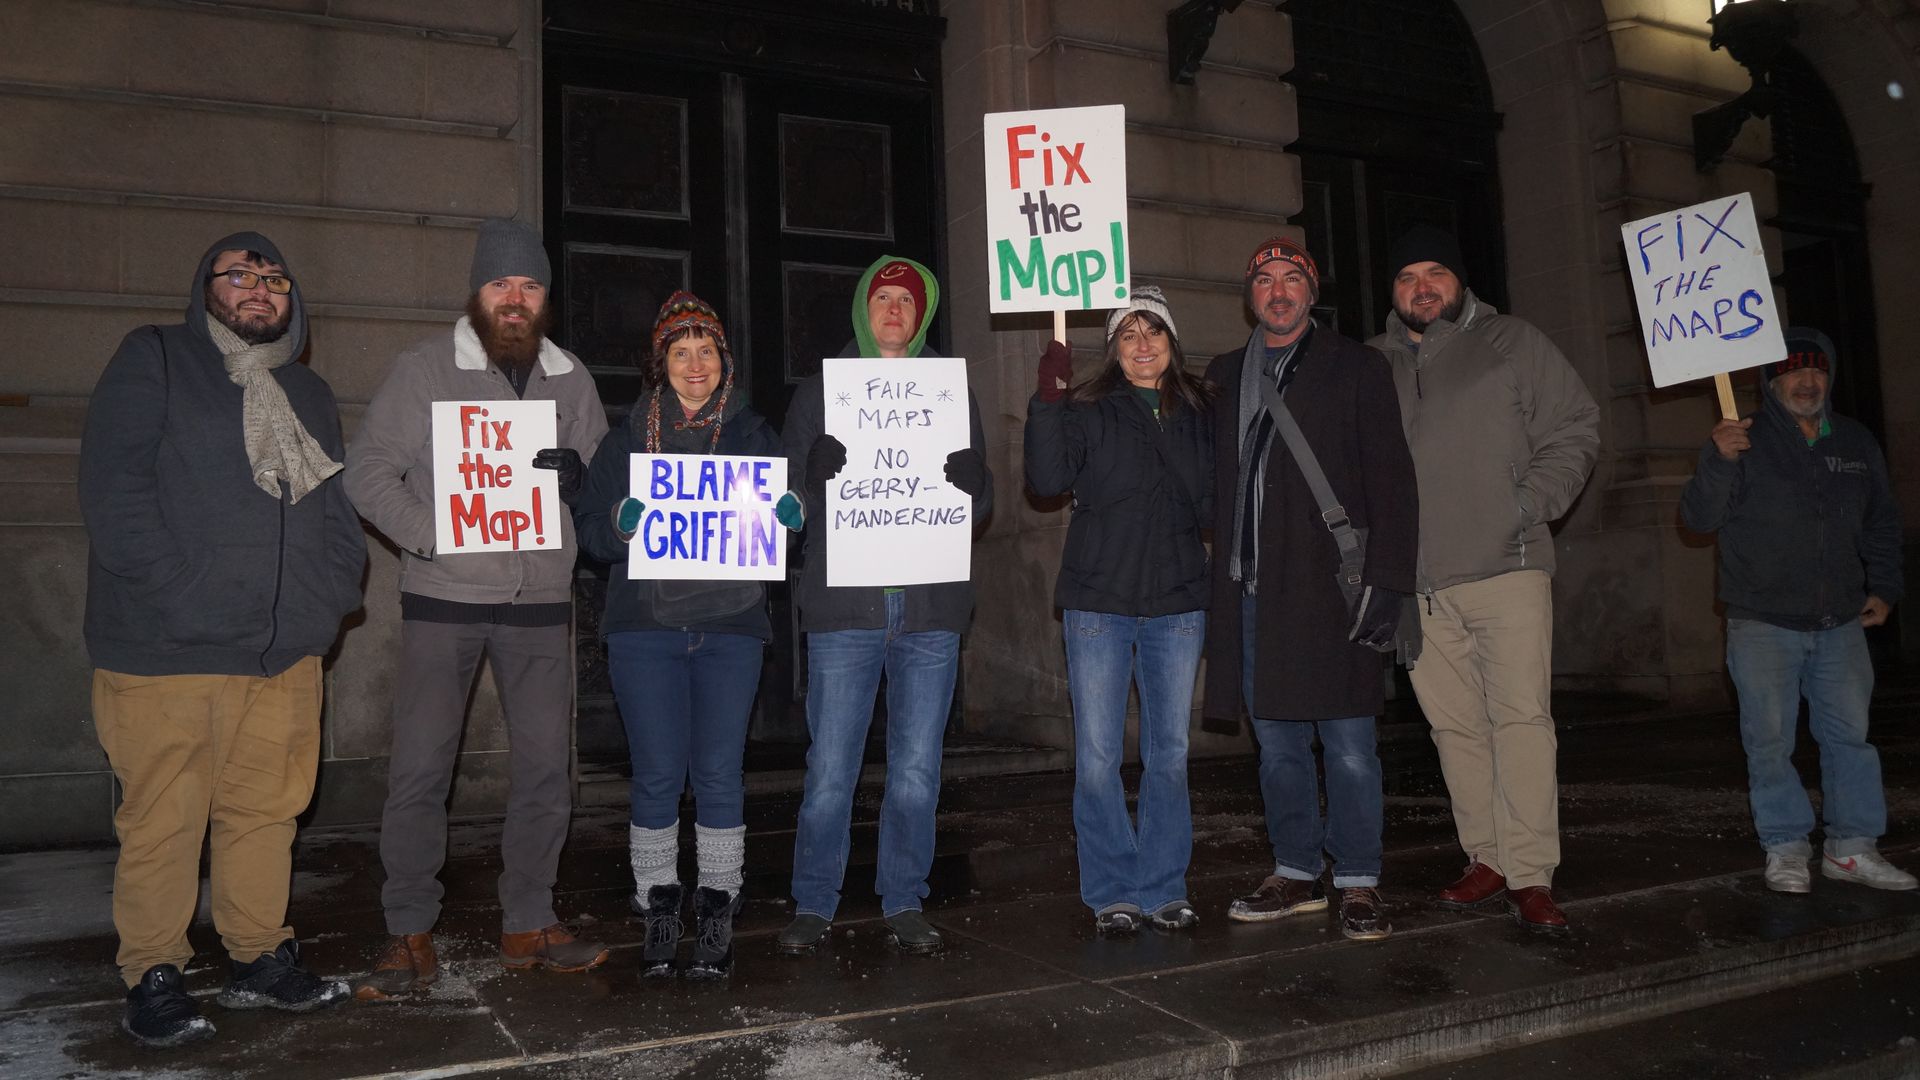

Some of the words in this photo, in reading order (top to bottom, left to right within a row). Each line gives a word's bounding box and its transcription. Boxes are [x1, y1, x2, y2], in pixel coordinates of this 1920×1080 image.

[1006, 124, 1092, 189] Fix
[1019, 189, 1082, 236] the
[996, 221, 1127, 309] Map!
[1654, 264, 1721, 305] THE
[1652, 289, 1764, 347] MAPS
[865, 377, 924, 400] FAIR
[460, 405, 513, 451] Fix
[858, 408, 934, 429] MAPS
[458, 452, 513, 490] the
[650, 459, 772, 502] BLAME
[874, 448, 909, 470] NO
[450, 486, 545, 550] Map!
[643, 508, 777, 567] GRIFFIN
[835, 506, 967, 530] MANDERING
